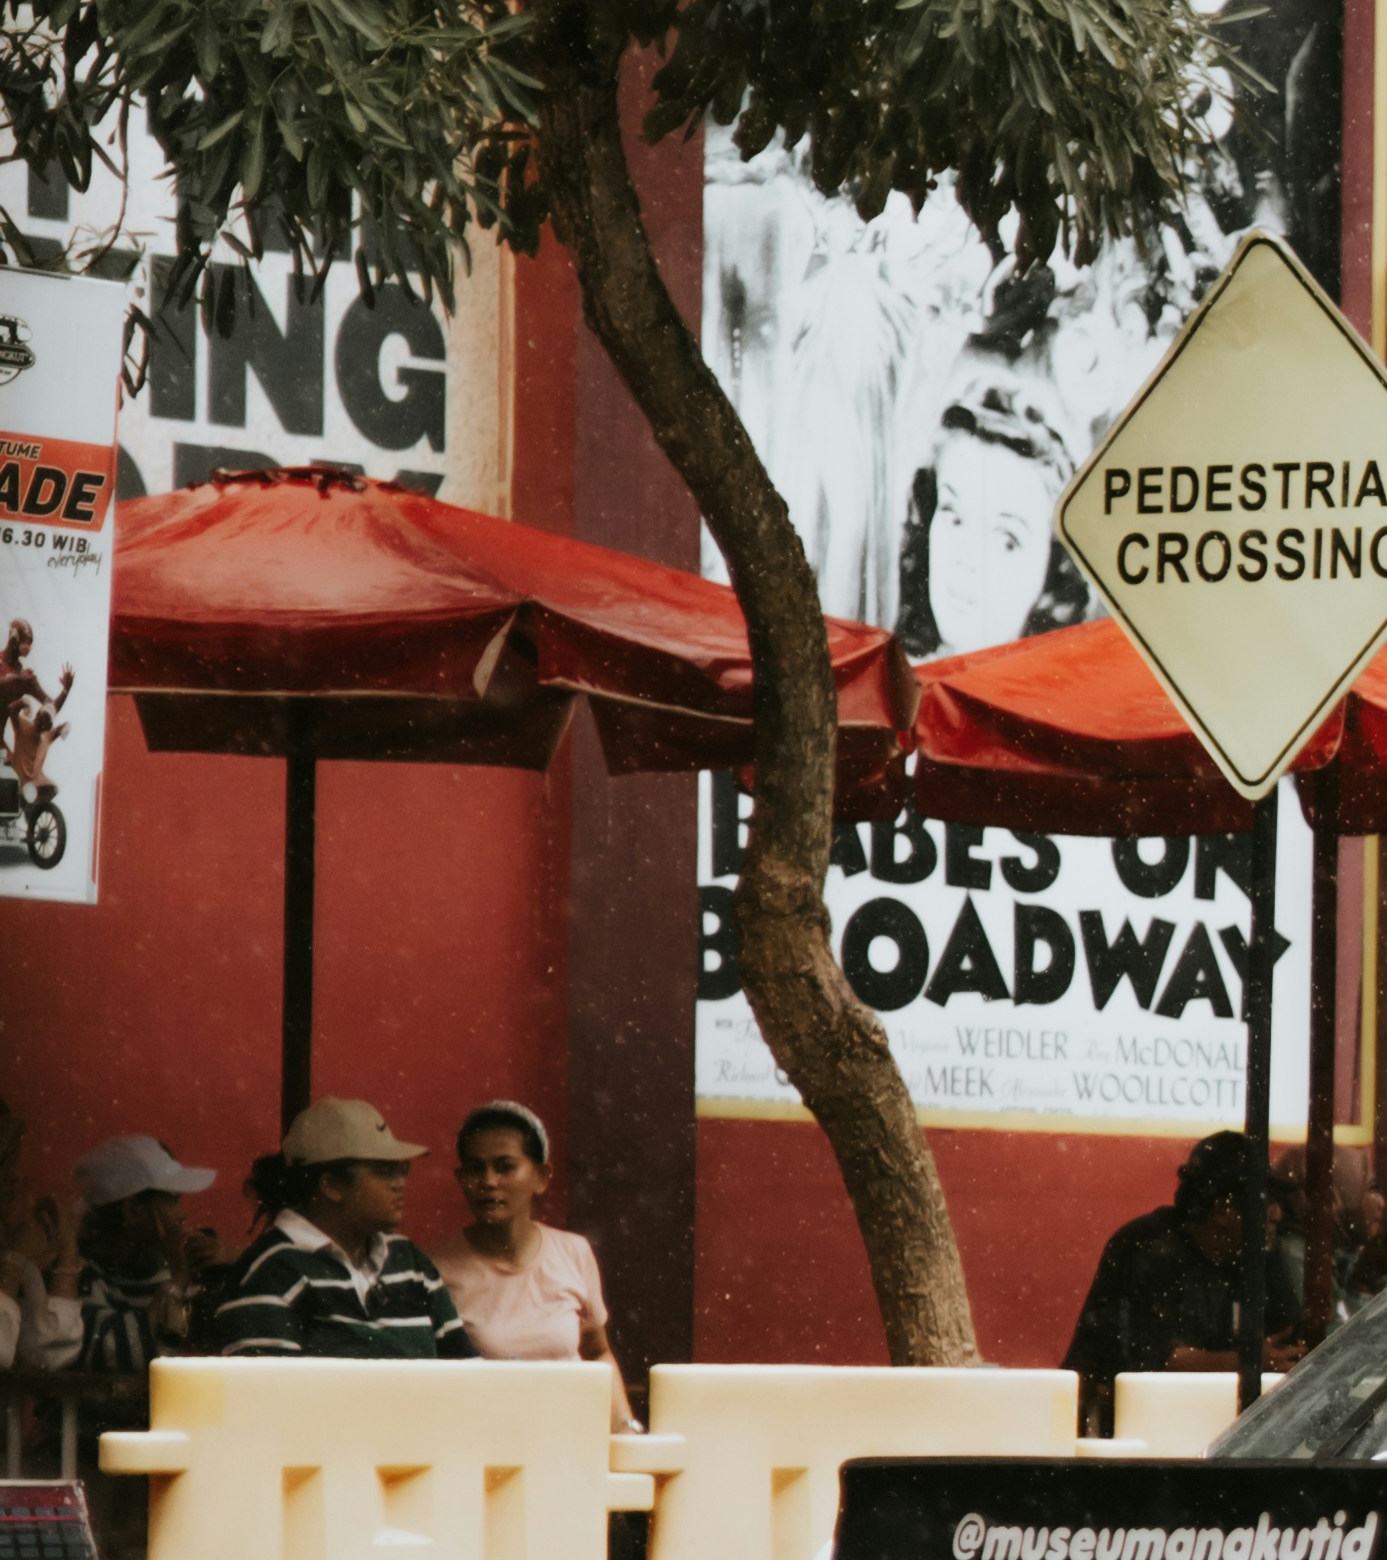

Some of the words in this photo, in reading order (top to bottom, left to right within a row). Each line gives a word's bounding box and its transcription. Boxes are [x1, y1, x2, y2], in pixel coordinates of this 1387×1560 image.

[52, 533, 88, 554] WIB
[711, 770, 1062, 894] BBES
[697, 885, 1292, 1022] BOADWAY
[955, 1024, 1069, 1061] WEIDLER
[1115, 1034, 1246, 1071] McDONAL
[925, 1064, 995, 1098] MEEK
[1072, 1070, 1242, 1109] WOOLLCOTT
